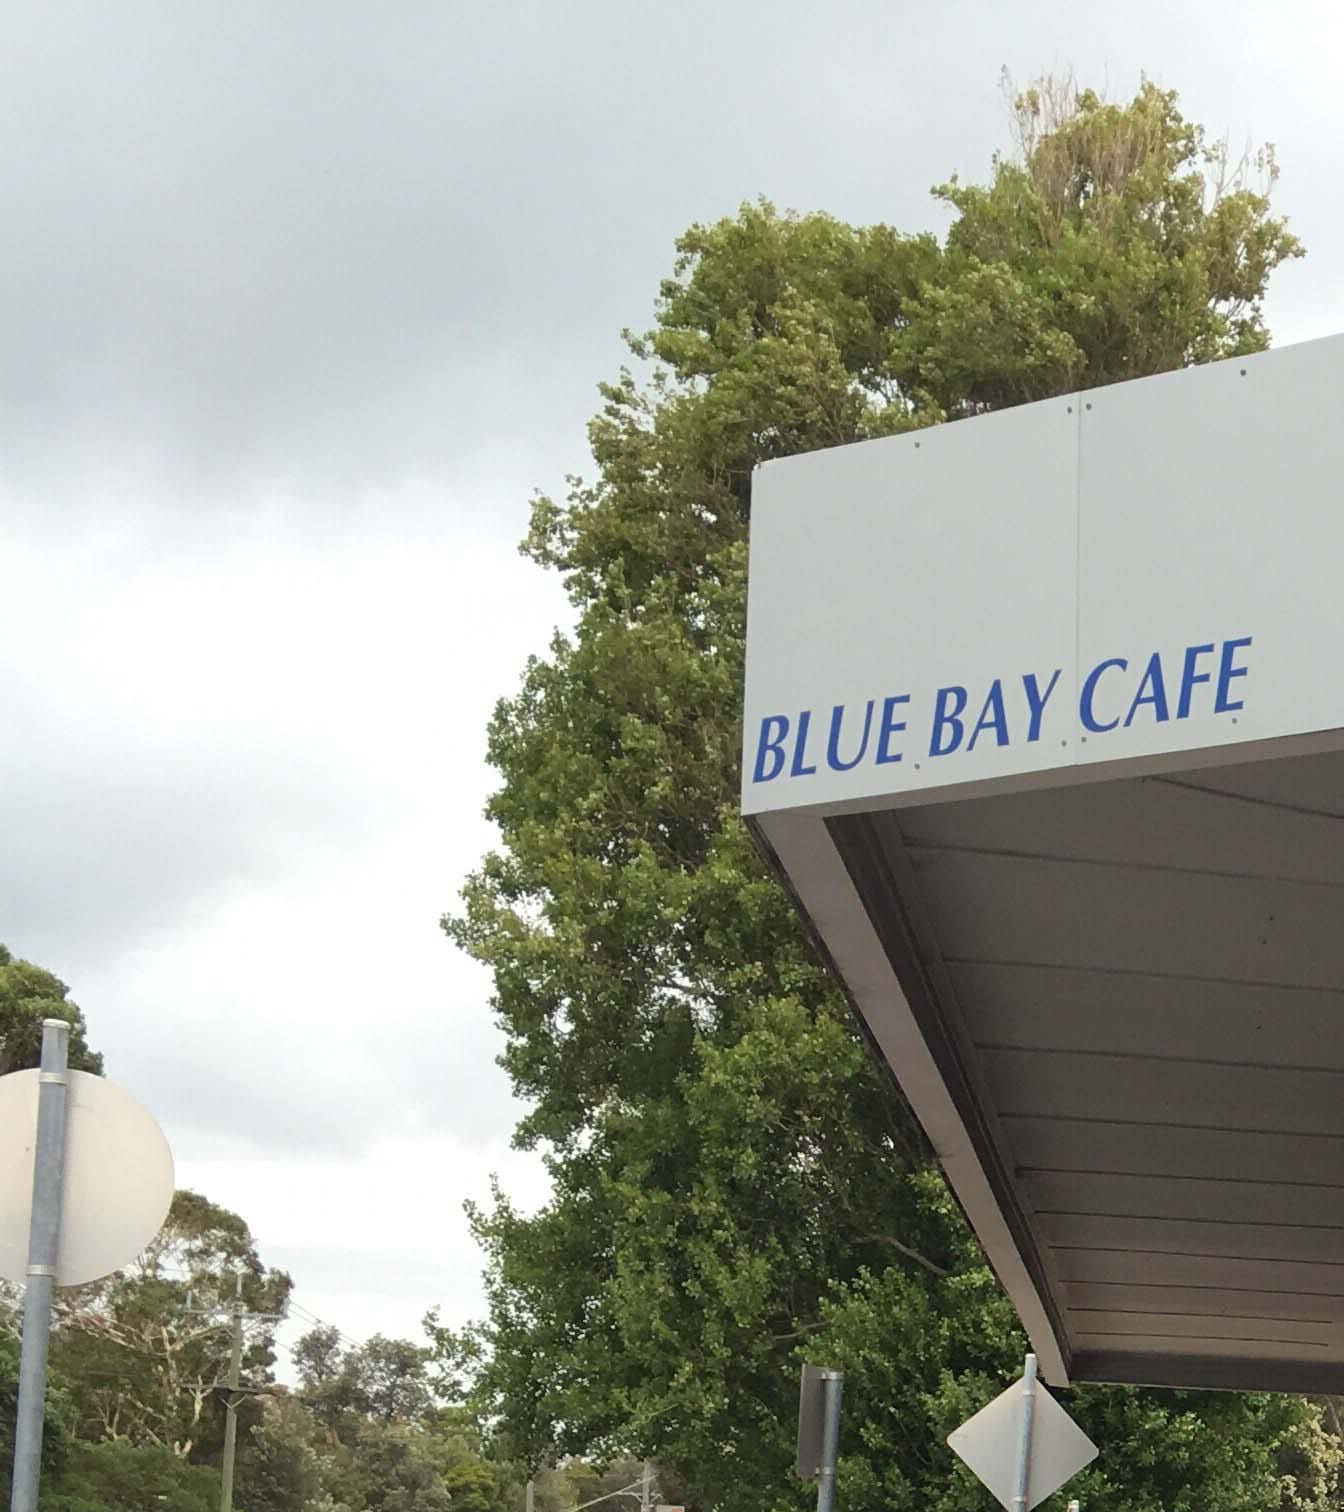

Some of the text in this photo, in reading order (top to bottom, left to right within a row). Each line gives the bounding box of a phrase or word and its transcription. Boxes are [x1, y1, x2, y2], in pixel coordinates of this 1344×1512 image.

[752, 636, 1253, 784] BLUE BAY CAFE
